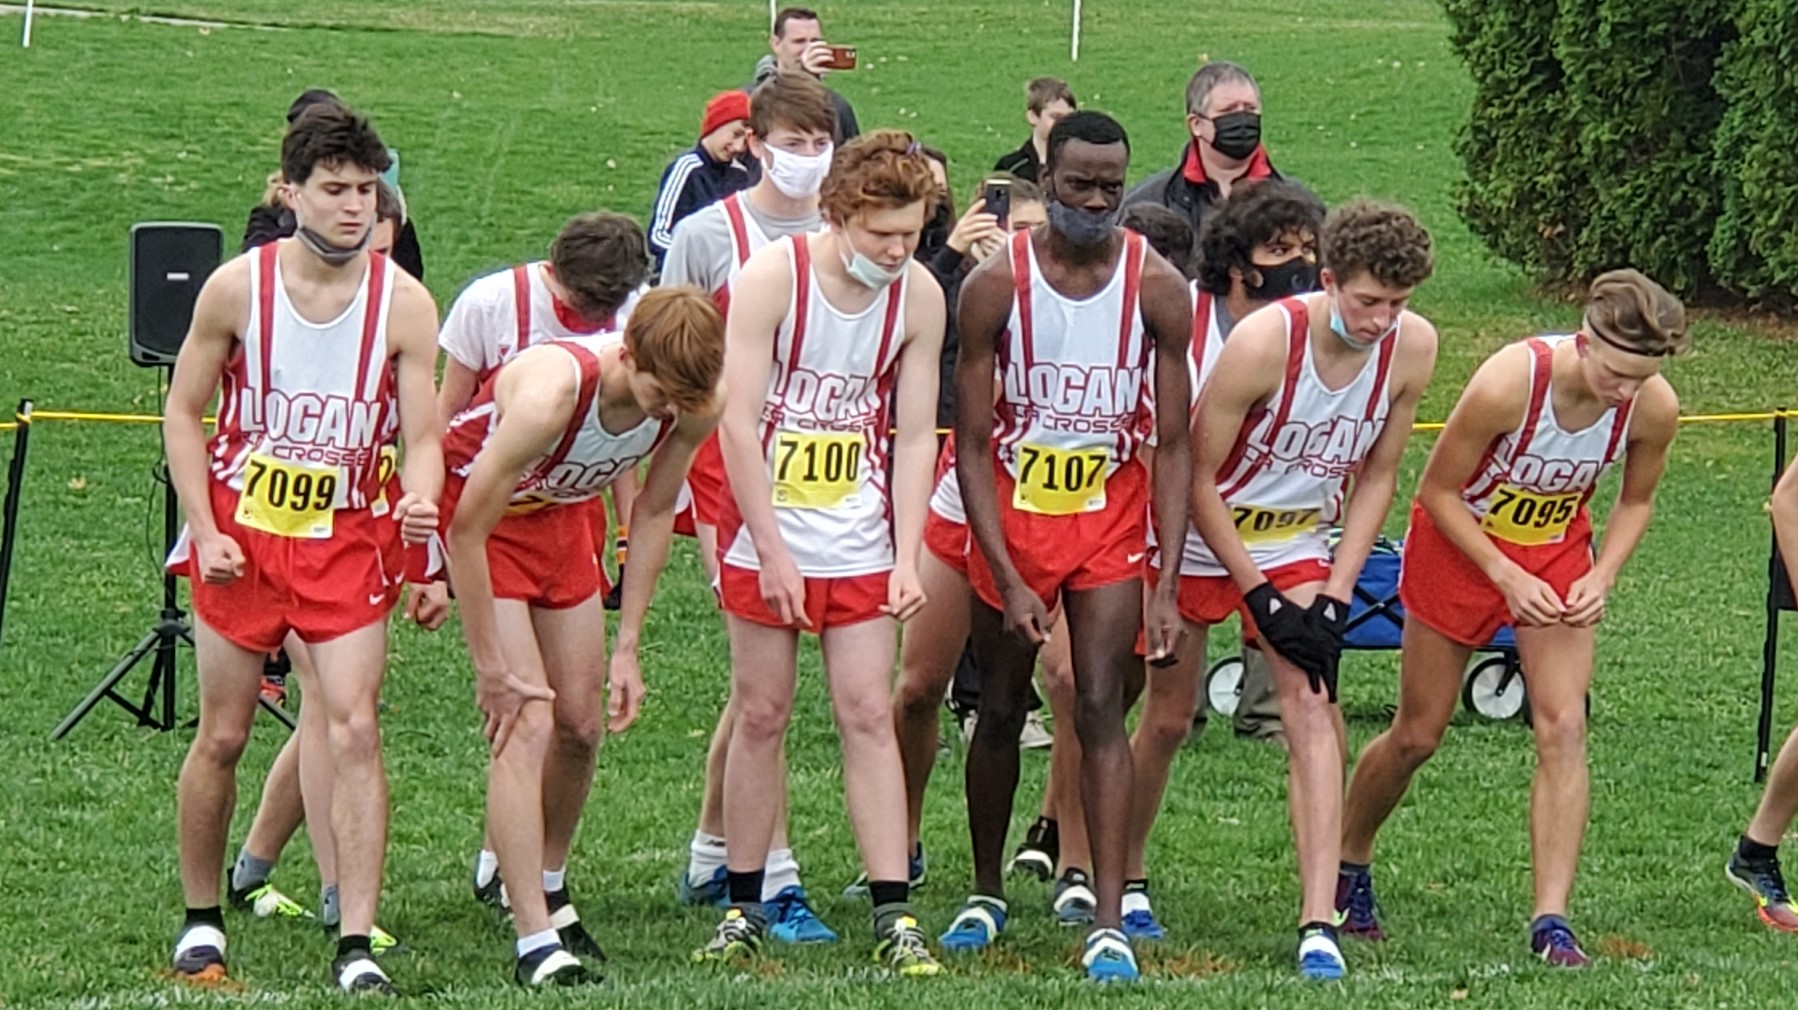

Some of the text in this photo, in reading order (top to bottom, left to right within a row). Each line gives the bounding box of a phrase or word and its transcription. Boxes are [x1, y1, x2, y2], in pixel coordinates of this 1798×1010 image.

[1004, 361, 1143, 418] LOGAN
[239, 386, 382, 451] LOGAN
[245, 459, 337, 512] 7099
[777, 440, 862, 483] 7100
[1019, 446, 1107, 492] 7107
[1492, 435, 1604, 494] LOGA
[1233, 506, 1322, 532] 7097
[1489, 489, 1578, 529] 7095
